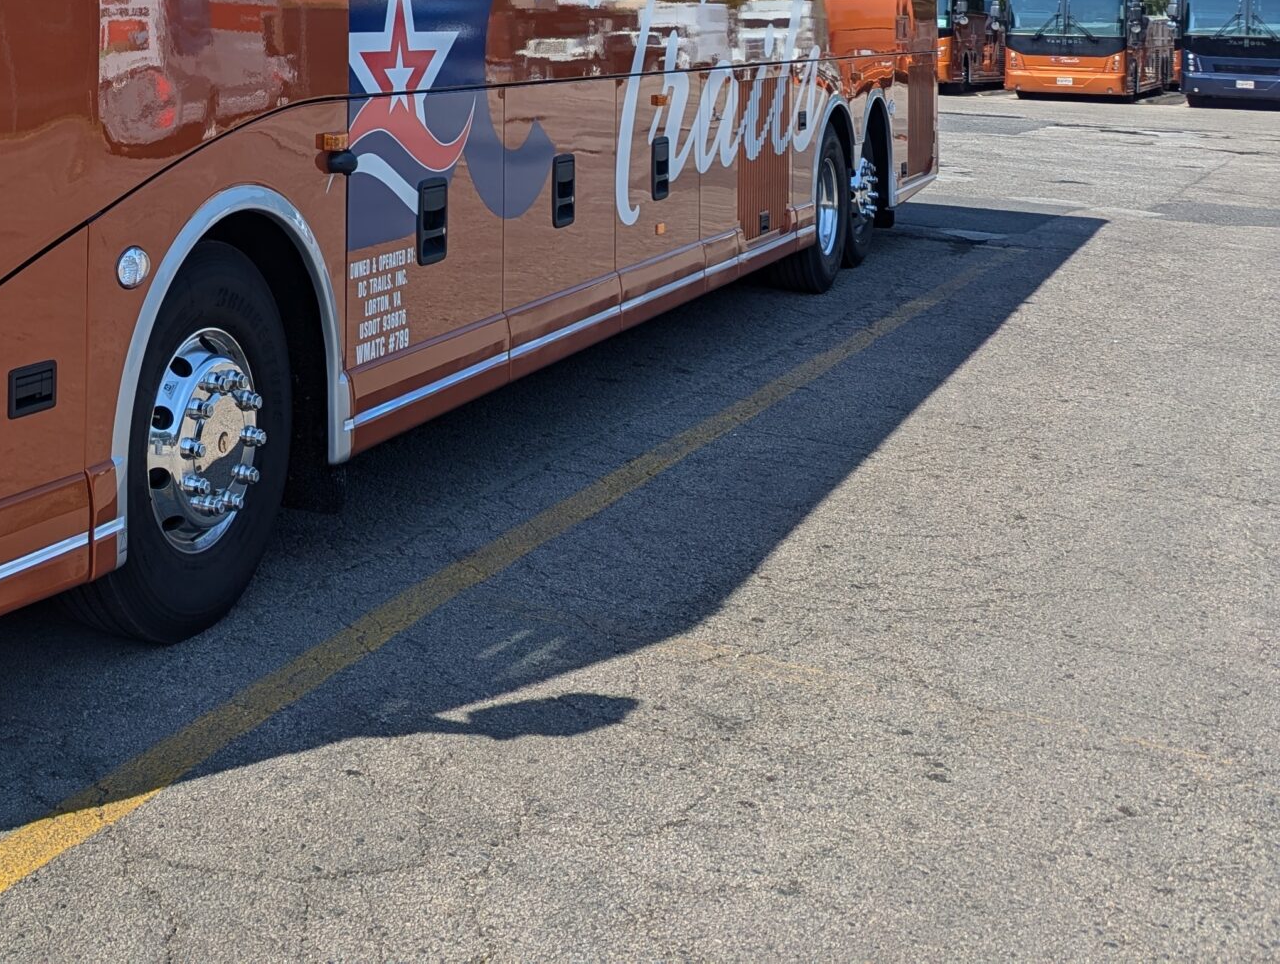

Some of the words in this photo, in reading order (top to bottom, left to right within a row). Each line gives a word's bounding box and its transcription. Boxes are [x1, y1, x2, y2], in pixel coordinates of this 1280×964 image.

[350, 258, 370, 279] OWNED
[372, 257, 377, 273] &
[379, 249, 406, 272] OPERATED
[407, 247, 416, 264] BY:
[358, 280, 367, 298] DC
[395, 269, 408, 286] INC.
[393, 291, 401, 307] VA
[359, 317, 381, 340] USDOT
[356, 336, 385, 365] WMATC
[388, 328, 409, 353] #789
